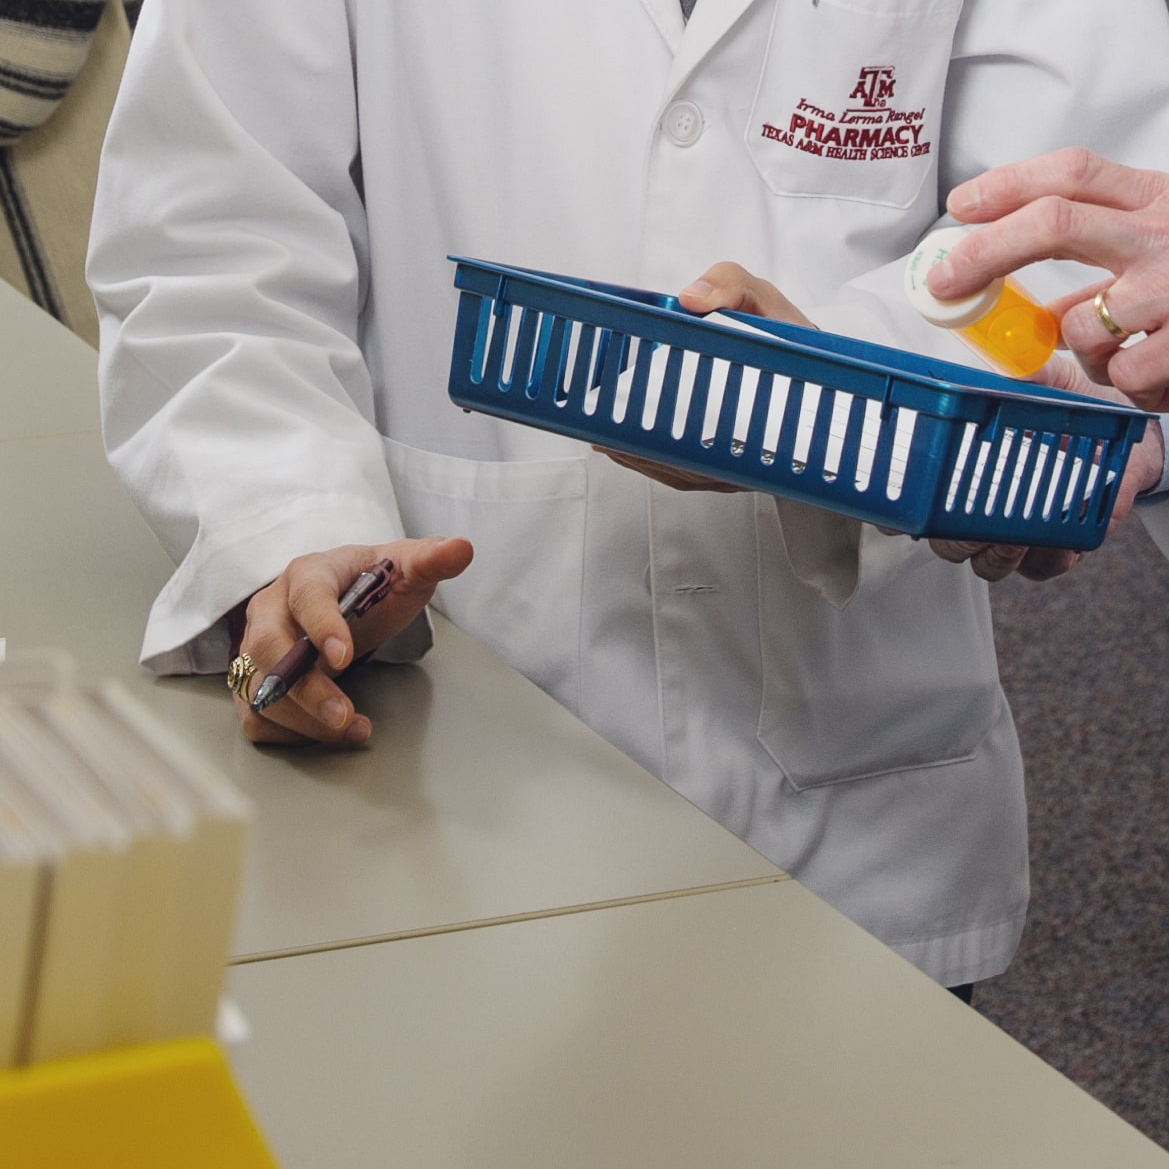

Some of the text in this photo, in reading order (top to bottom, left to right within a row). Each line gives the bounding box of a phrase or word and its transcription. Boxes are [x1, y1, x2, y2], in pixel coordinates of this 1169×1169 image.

[796, 97, 926, 125] Irma Lerma Rangel
[761, 124, 795, 147] TEXAS
[825, 146, 868, 161] HEALTH
[870, 145, 909, 161] SCIENCE
[789, 113, 924, 148] PHARMACY
